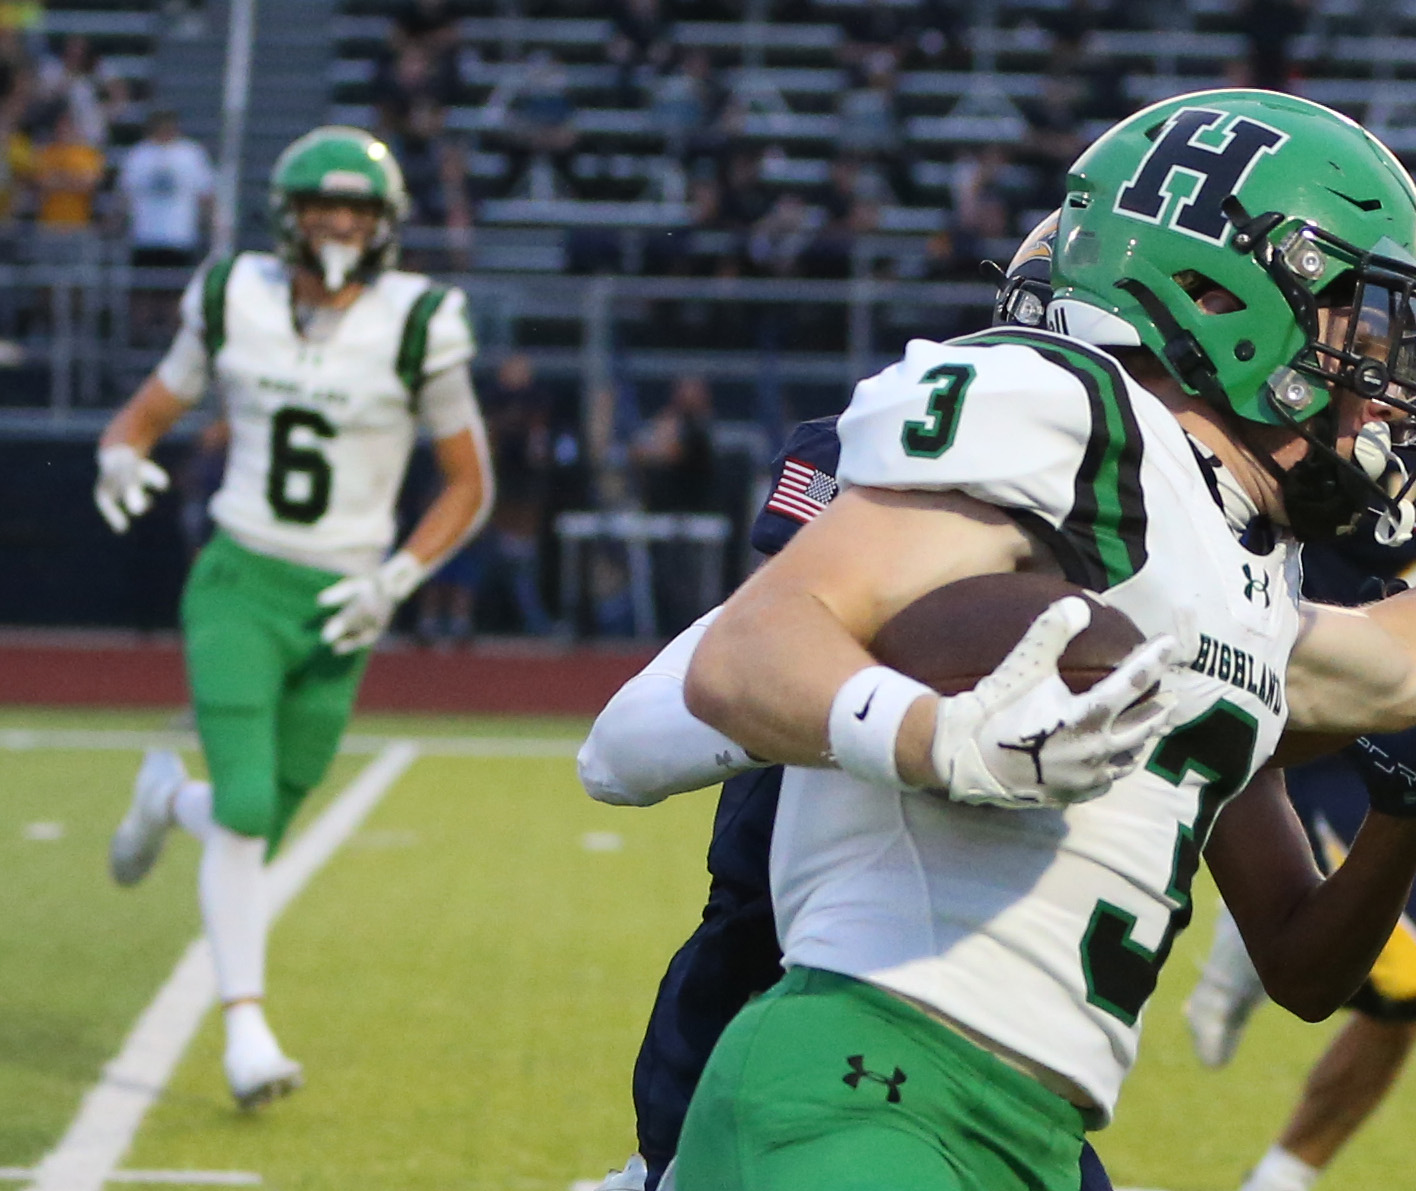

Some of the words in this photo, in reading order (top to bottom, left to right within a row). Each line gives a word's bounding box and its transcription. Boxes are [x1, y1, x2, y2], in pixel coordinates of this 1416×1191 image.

[1112, 106, 1290, 247] H
[267, 404, 338, 526] 6
[902, 362, 976, 460] 3
[1190, 632, 1281, 716] HIGHLAND
[1080, 698, 1259, 1028] 3
